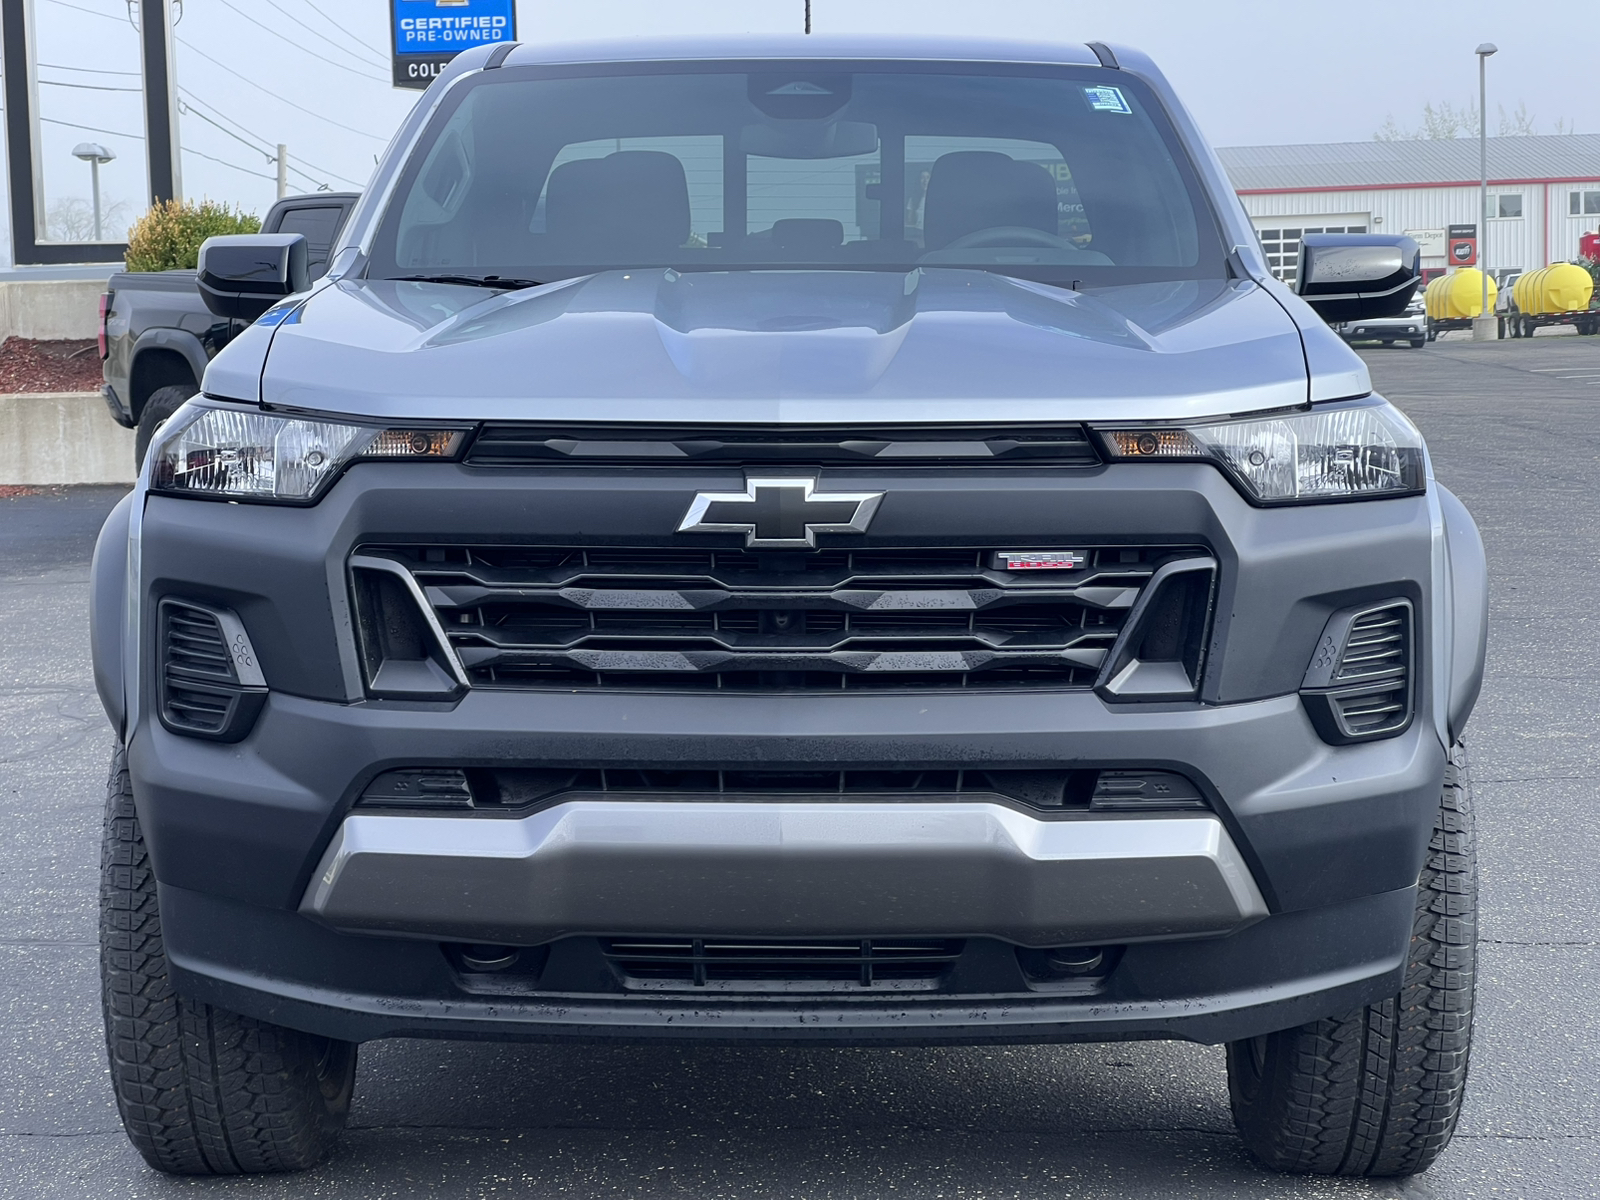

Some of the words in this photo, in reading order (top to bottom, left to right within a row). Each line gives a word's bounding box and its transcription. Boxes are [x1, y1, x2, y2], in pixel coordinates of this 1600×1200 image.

[400, 16, 507, 30] CERTIFIED
[406, 29, 502, 42] PRE-OWNED
[1424, 231, 1443, 240] Depot
[1007, 561, 1074, 570] BOSS
